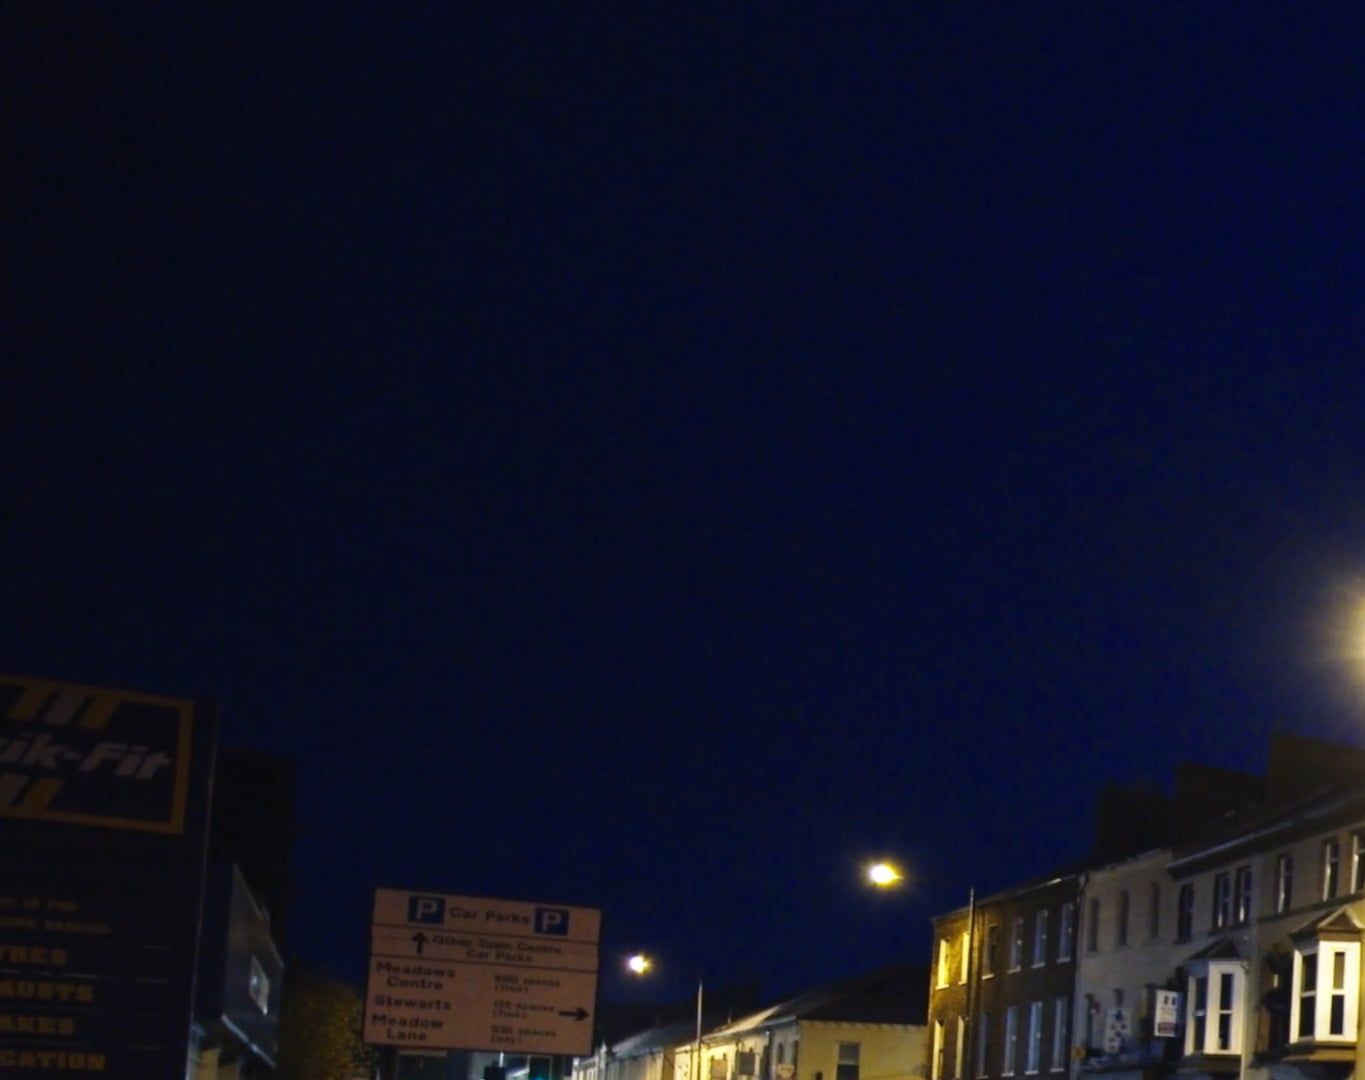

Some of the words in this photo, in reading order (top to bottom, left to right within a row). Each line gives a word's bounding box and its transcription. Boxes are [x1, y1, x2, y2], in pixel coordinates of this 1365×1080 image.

[449, 907, 478, 920] Car
[485, 910, 530, 925] Parks
[432, 935, 473, 947] Other
[478, 938, 513, 950] Town
[516, 942, 562, 955] Centre
[466, 949, 490, 960] Car
[495, 951, 533, 963] Parks
[376, 961, 456, 978] Meadows
[386, 977, 443, 990] Centre
[374, 994, 452, 1011] Stewarts
[371, 1013, 444, 1029] Meadow
[386, 1028, 427, 1041] Lane
